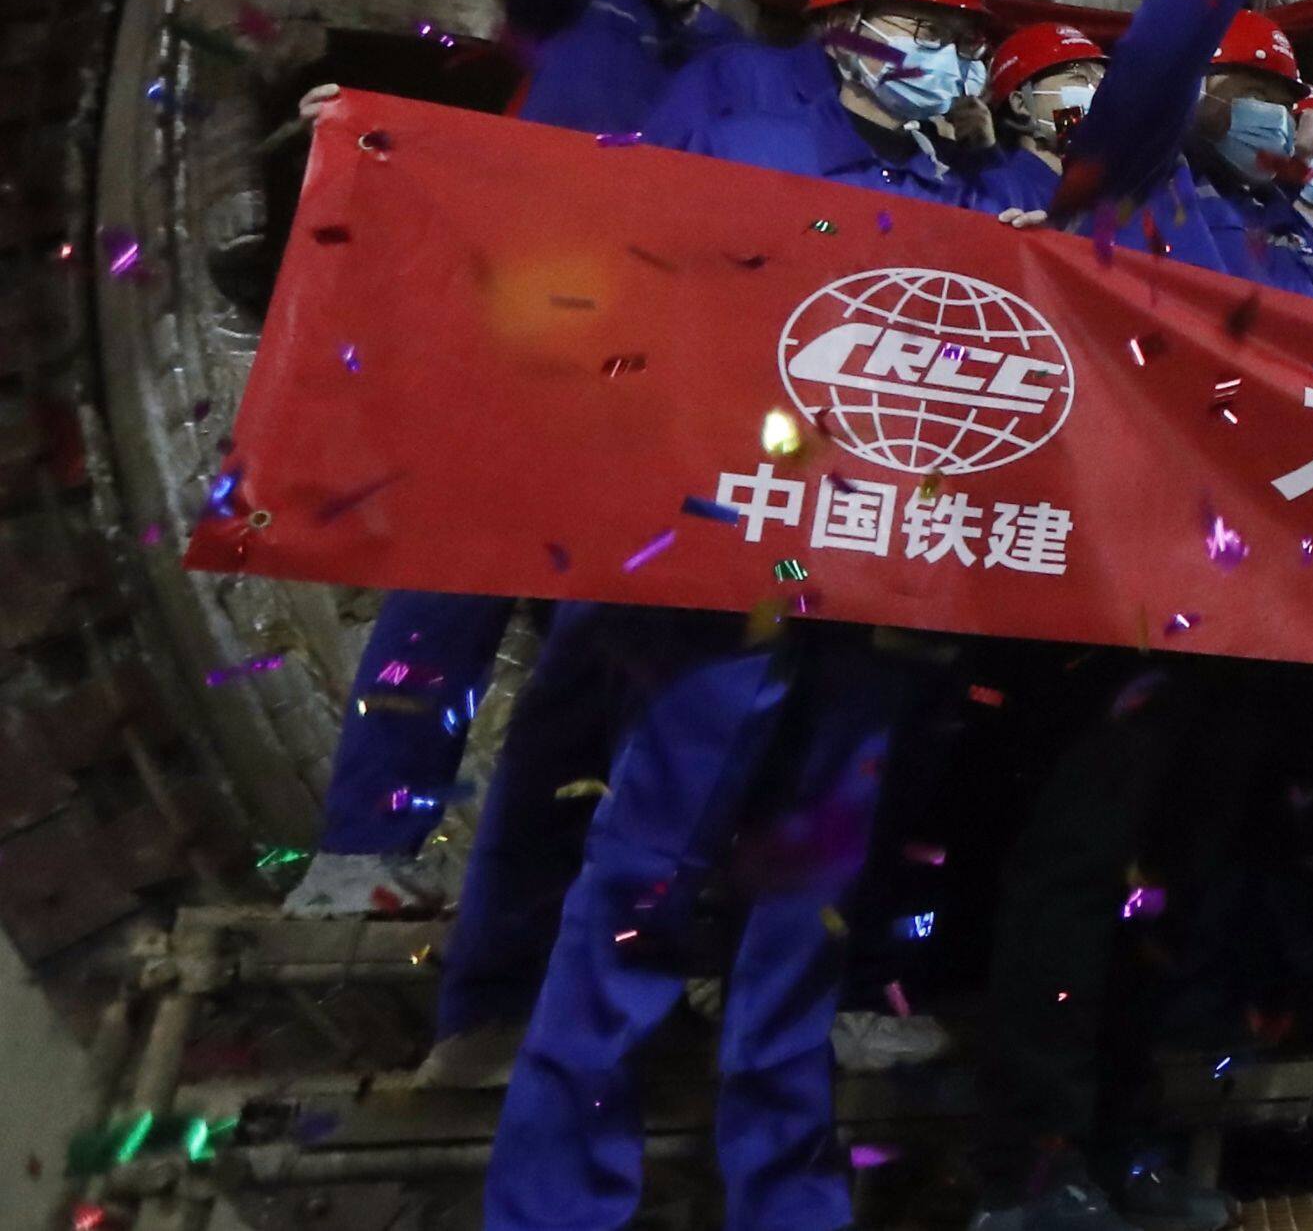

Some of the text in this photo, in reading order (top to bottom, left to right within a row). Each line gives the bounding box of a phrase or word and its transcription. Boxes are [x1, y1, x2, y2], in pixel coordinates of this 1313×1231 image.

[788, 322, 1066, 414] CRCC
[715, 462, 1074, 575] 中国铁建
